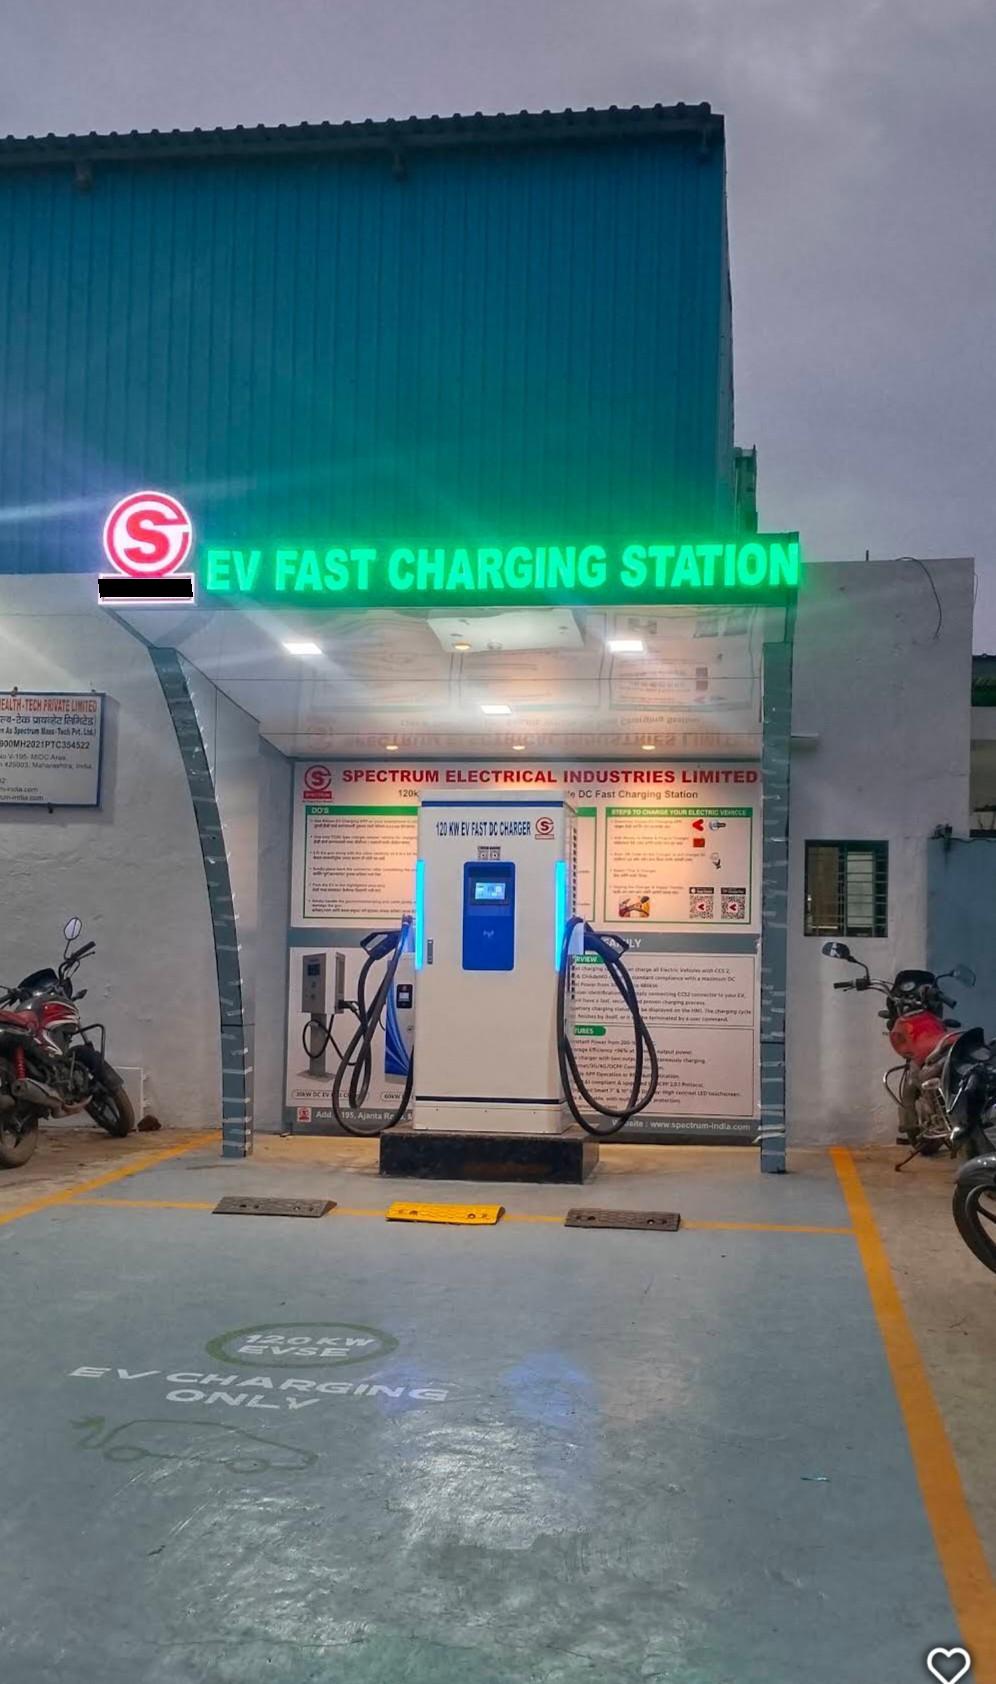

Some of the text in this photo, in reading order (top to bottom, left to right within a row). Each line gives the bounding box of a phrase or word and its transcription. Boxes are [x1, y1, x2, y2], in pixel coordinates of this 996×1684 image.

[207, 542, 800, 592] EV FAST CHARGING STATION
[71, 700, 97, 713] LIMITED
[343, 770, 758, 783] SPECTRUM ELECTRICAL INDUSTRIES LIMITED
[579, 790, 699, 801] DC Fast Charging Station
[436, 821, 531, 836] 120 KW EV FAST DC CHARGER
[358, 1112, 382, 1121] Ajanta
[649, 1120, 751, 1131] www.spectrum-india.com
[321, 1335, 376, 1347] KW
[238, 1344, 351, 1357] EVSE
[68, 1365, 451, 1402] EV CHARGING
[166, 1388, 321, 1410] ONLY
